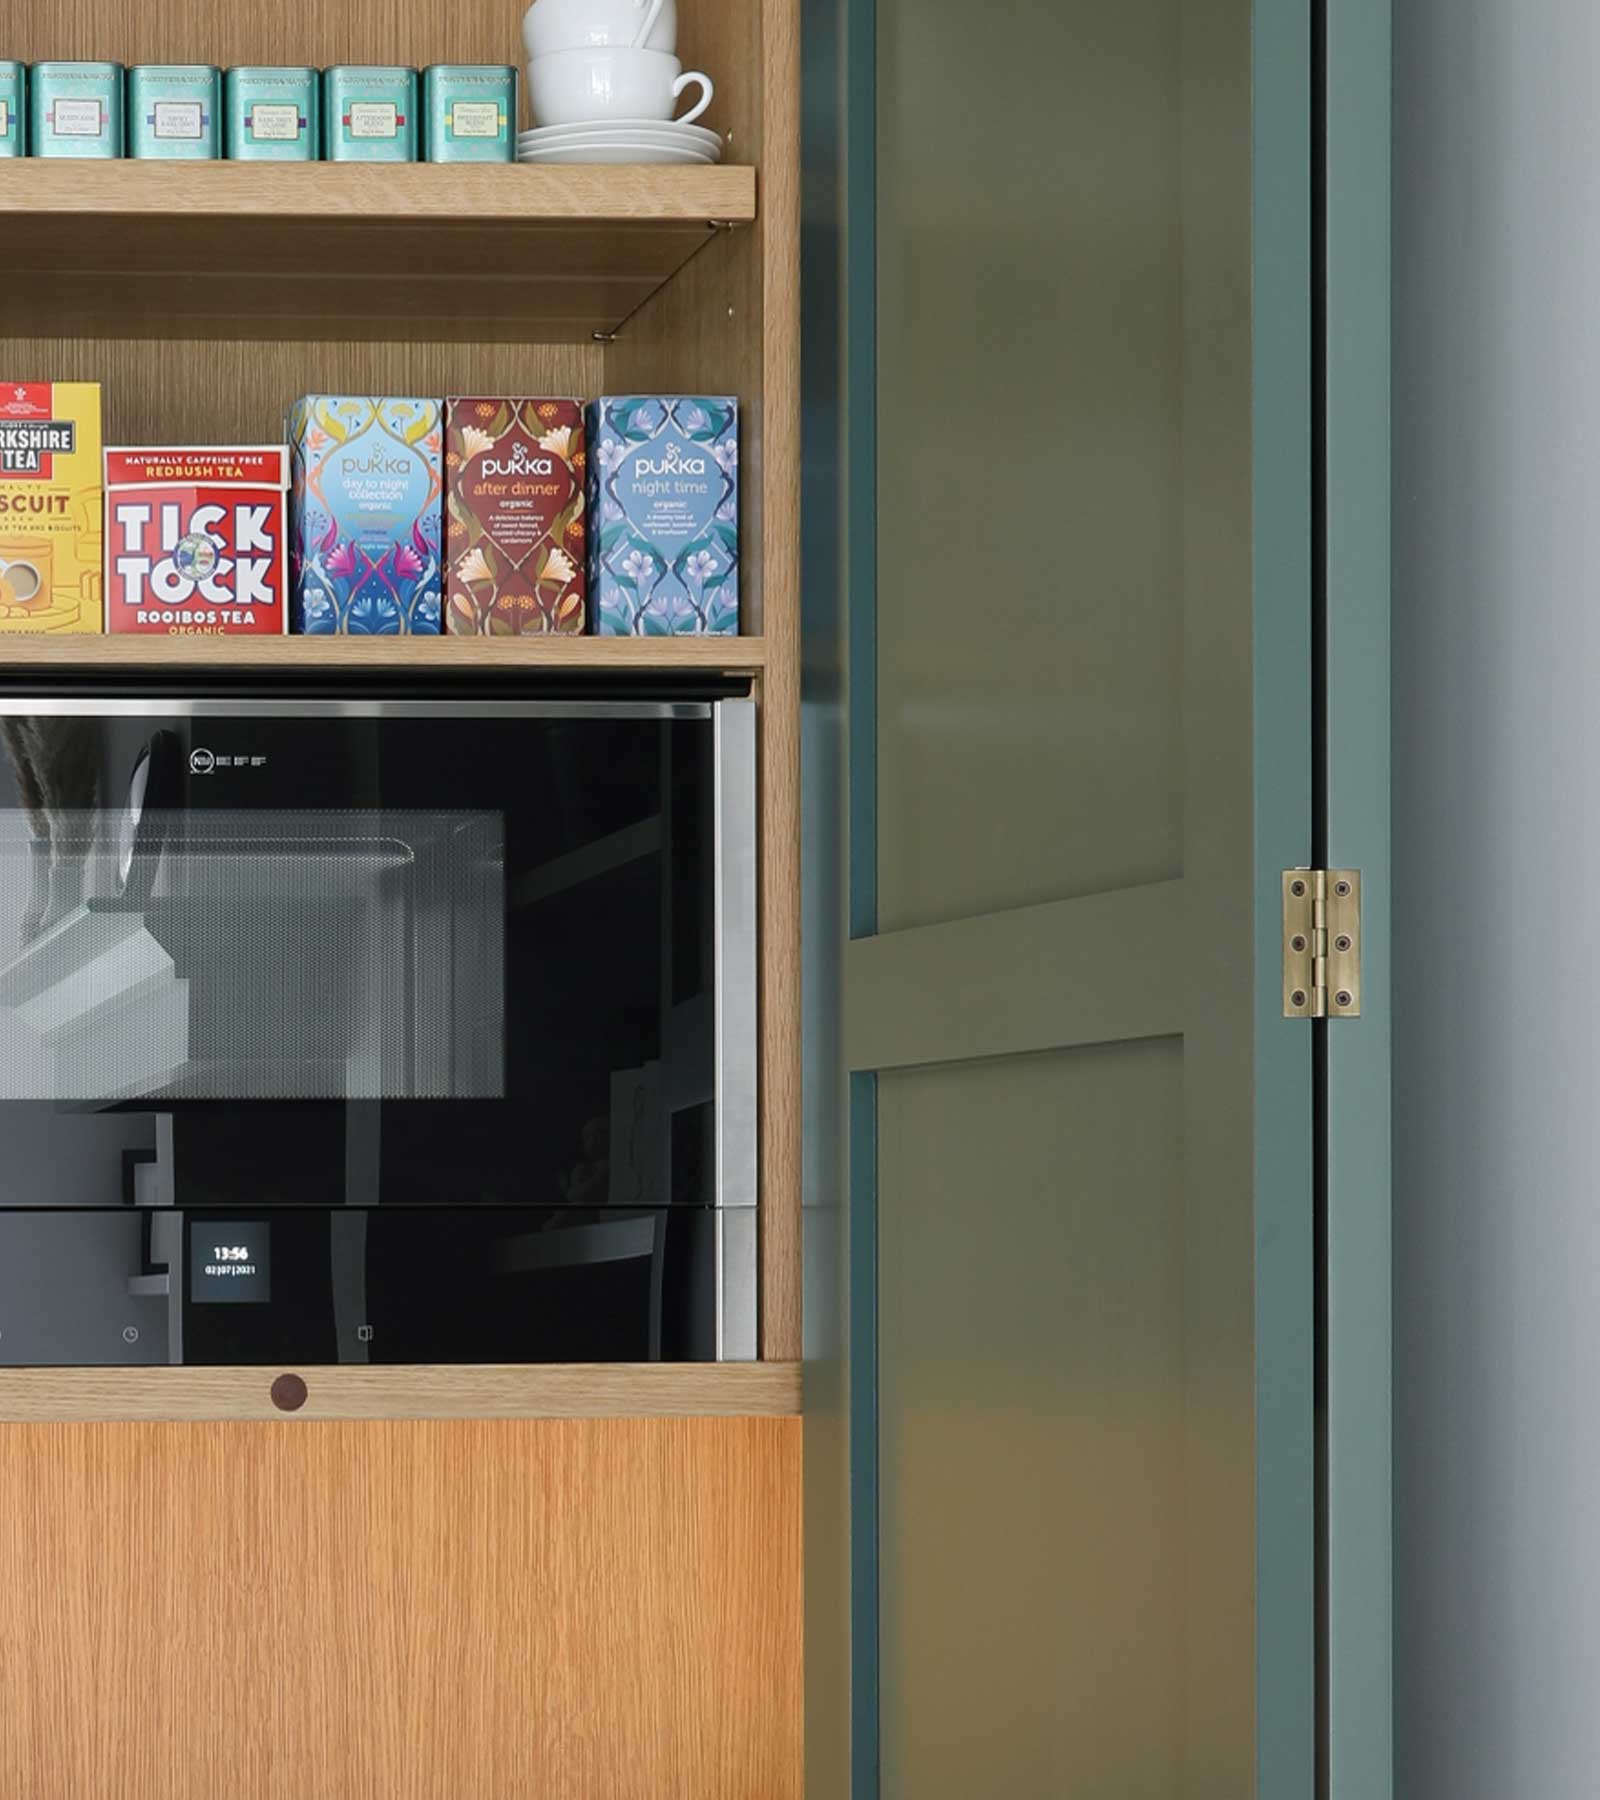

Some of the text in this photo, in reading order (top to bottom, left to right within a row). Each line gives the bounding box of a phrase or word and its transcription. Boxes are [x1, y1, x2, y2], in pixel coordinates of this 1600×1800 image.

[4, 450, 37, 468] TEA
[125, 456, 264, 465] NATURALLY CAFFEINE FREE
[342, 455, 411, 475] pukka
[146, 466, 244, 477] REDBUSH TEA
[482, 455, 552, 479] pukka
[635, 455, 705, 479] pukka
[342, 479, 363, 490] day
[366, 479, 378, 489] to
[473, 481, 560, 495] after dinner
[632, 480, 708, 497] night time
[348, 488, 403, 500] collection
[498, 500, 534, 509] organic
[116, 505, 274, 552] TICK
[116, 557, 274, 604] TOCK
[137, 611, 255, 624] ROOIBOS TEA
[168, 626, 225, 635] ORGANIC
[214, 1246, 249, 1261] 13:56
